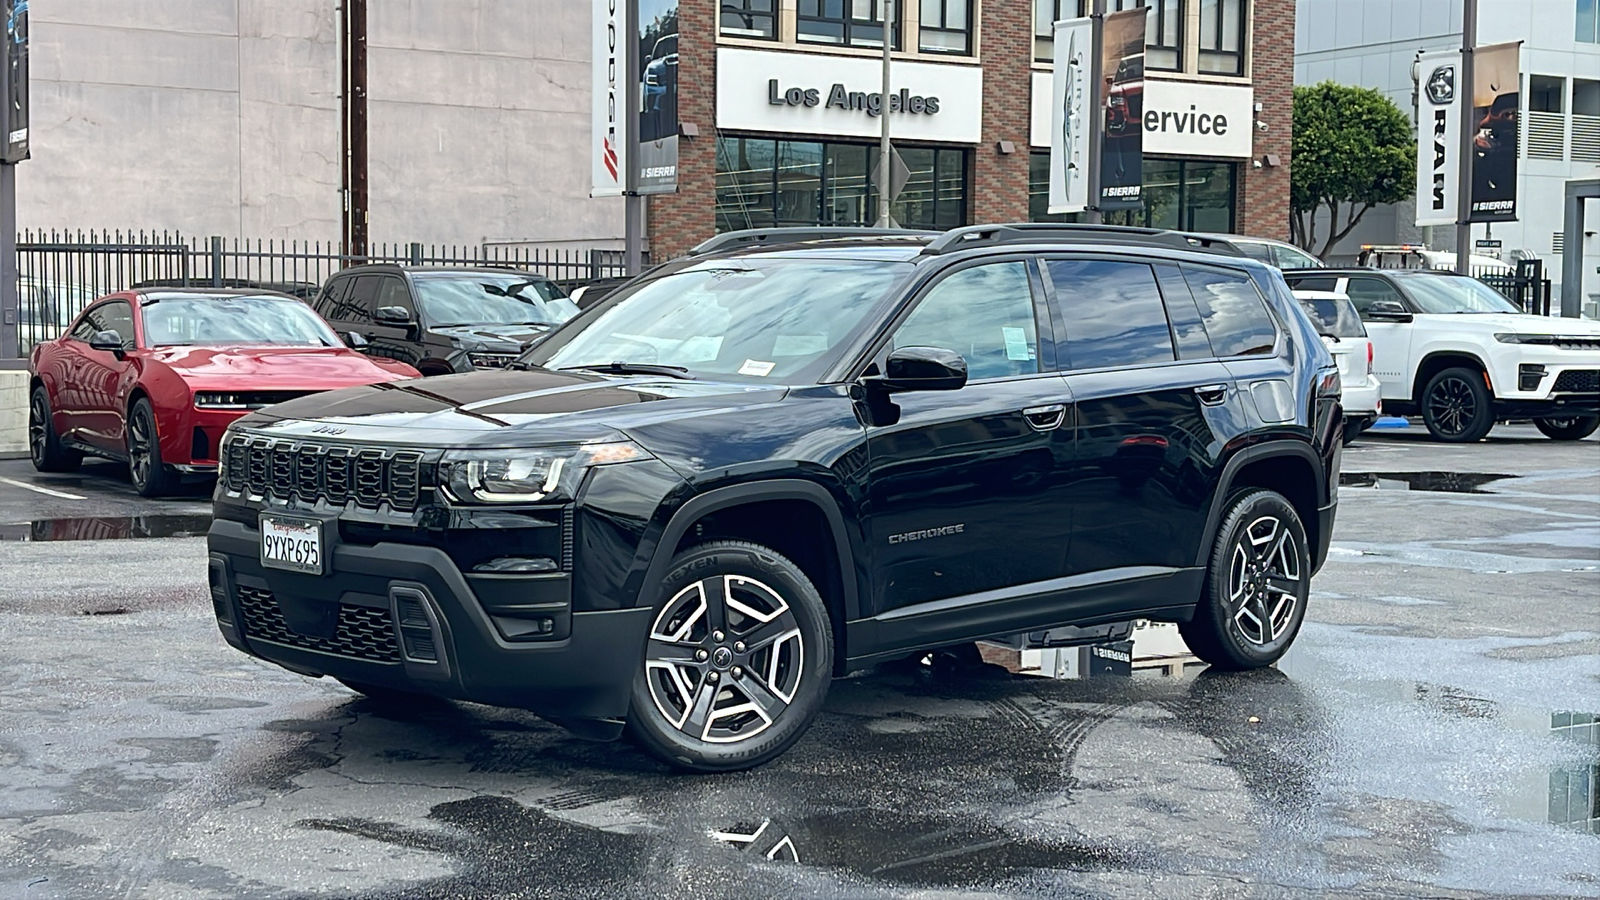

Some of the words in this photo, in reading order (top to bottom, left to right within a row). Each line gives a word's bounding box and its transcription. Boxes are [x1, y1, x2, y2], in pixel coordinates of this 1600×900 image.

[768, 79, 820, 107] Los
[825, 83, 940, 117] Angeles
[1073, 51, 1083, 180] CHRYSLER
[1144, 104, 1228, 136] ervice
[646, 165, 676, 178] SIERRA
[1432, 109, 1447, 211] RAM
[1108, 185, 1141, 197] SIERRA
[1479, 200, 1514, 211] SIERRA
[265, 534, 319, 565] 9YXP695
[888, 523, 965, 545] CHEROKEE
